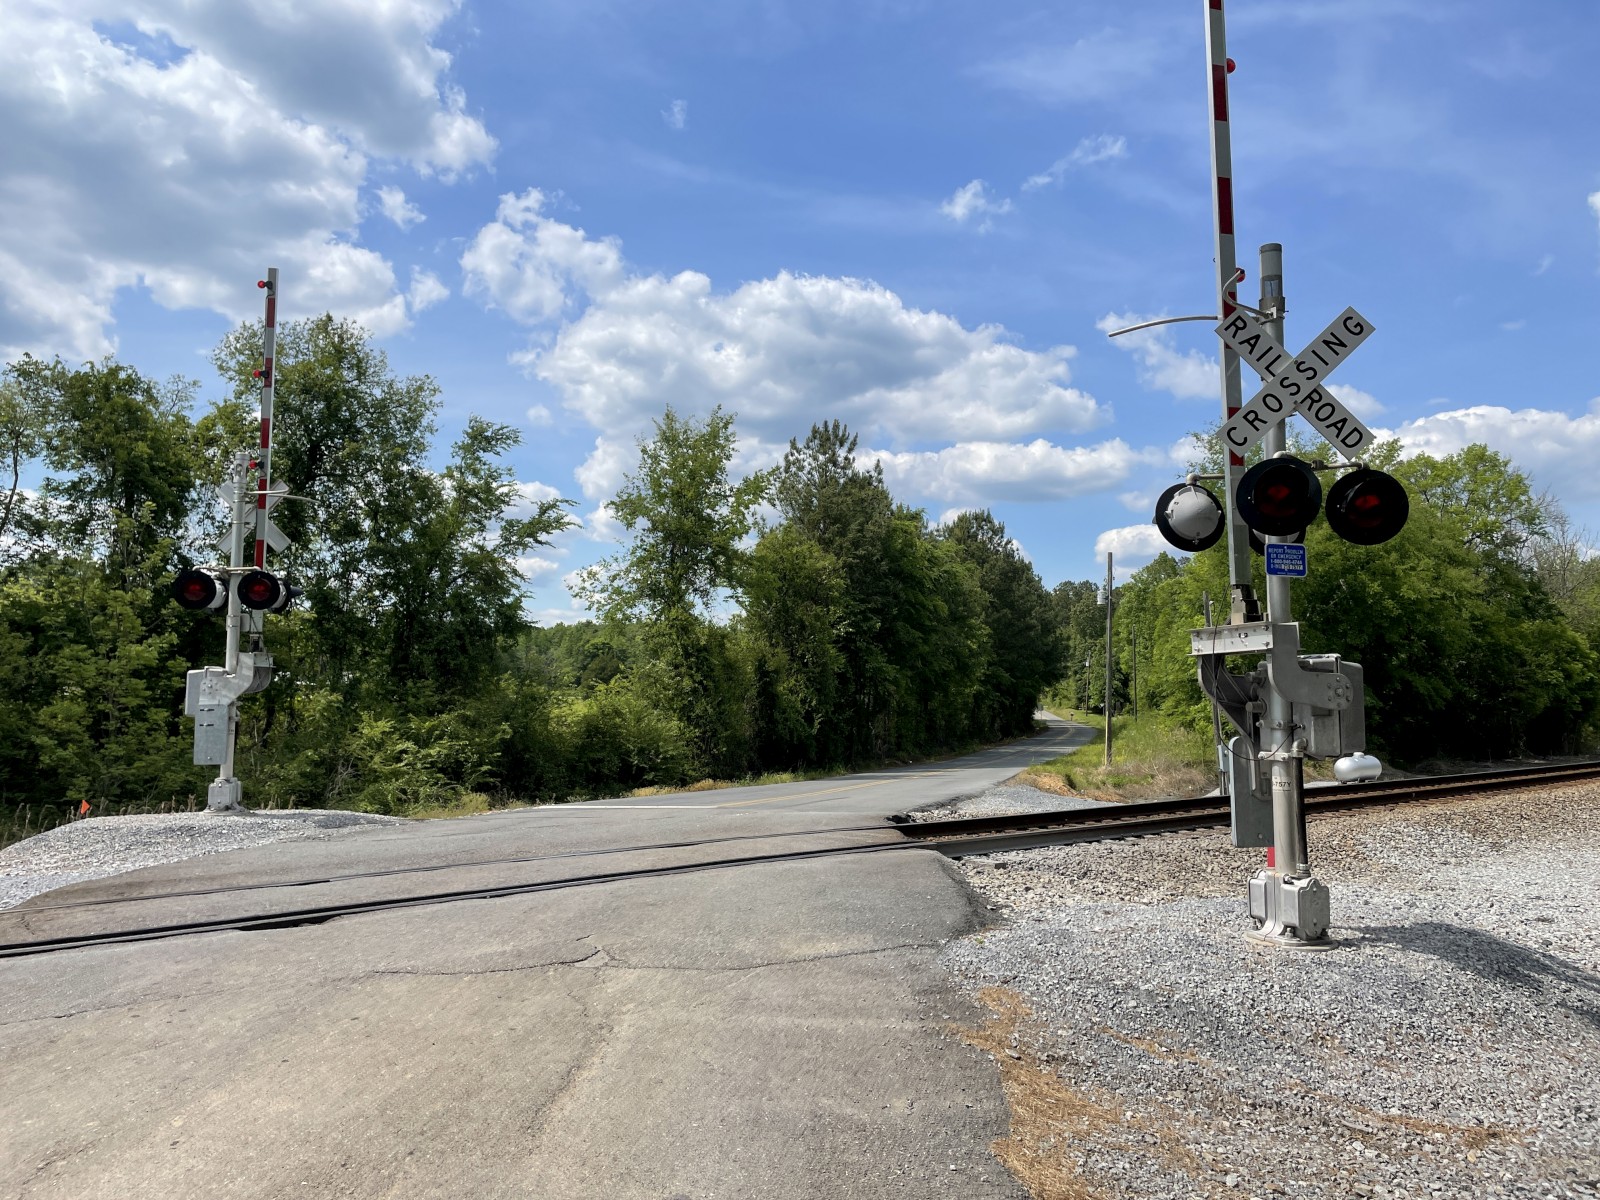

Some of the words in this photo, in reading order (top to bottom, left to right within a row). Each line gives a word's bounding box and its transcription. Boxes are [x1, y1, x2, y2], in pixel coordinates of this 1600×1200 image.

[1224, 315, 1282, 377] RAIL
[1299, 388, 1364, 448] ROAD
[1226, 316, 1364, 447] CROSSING
